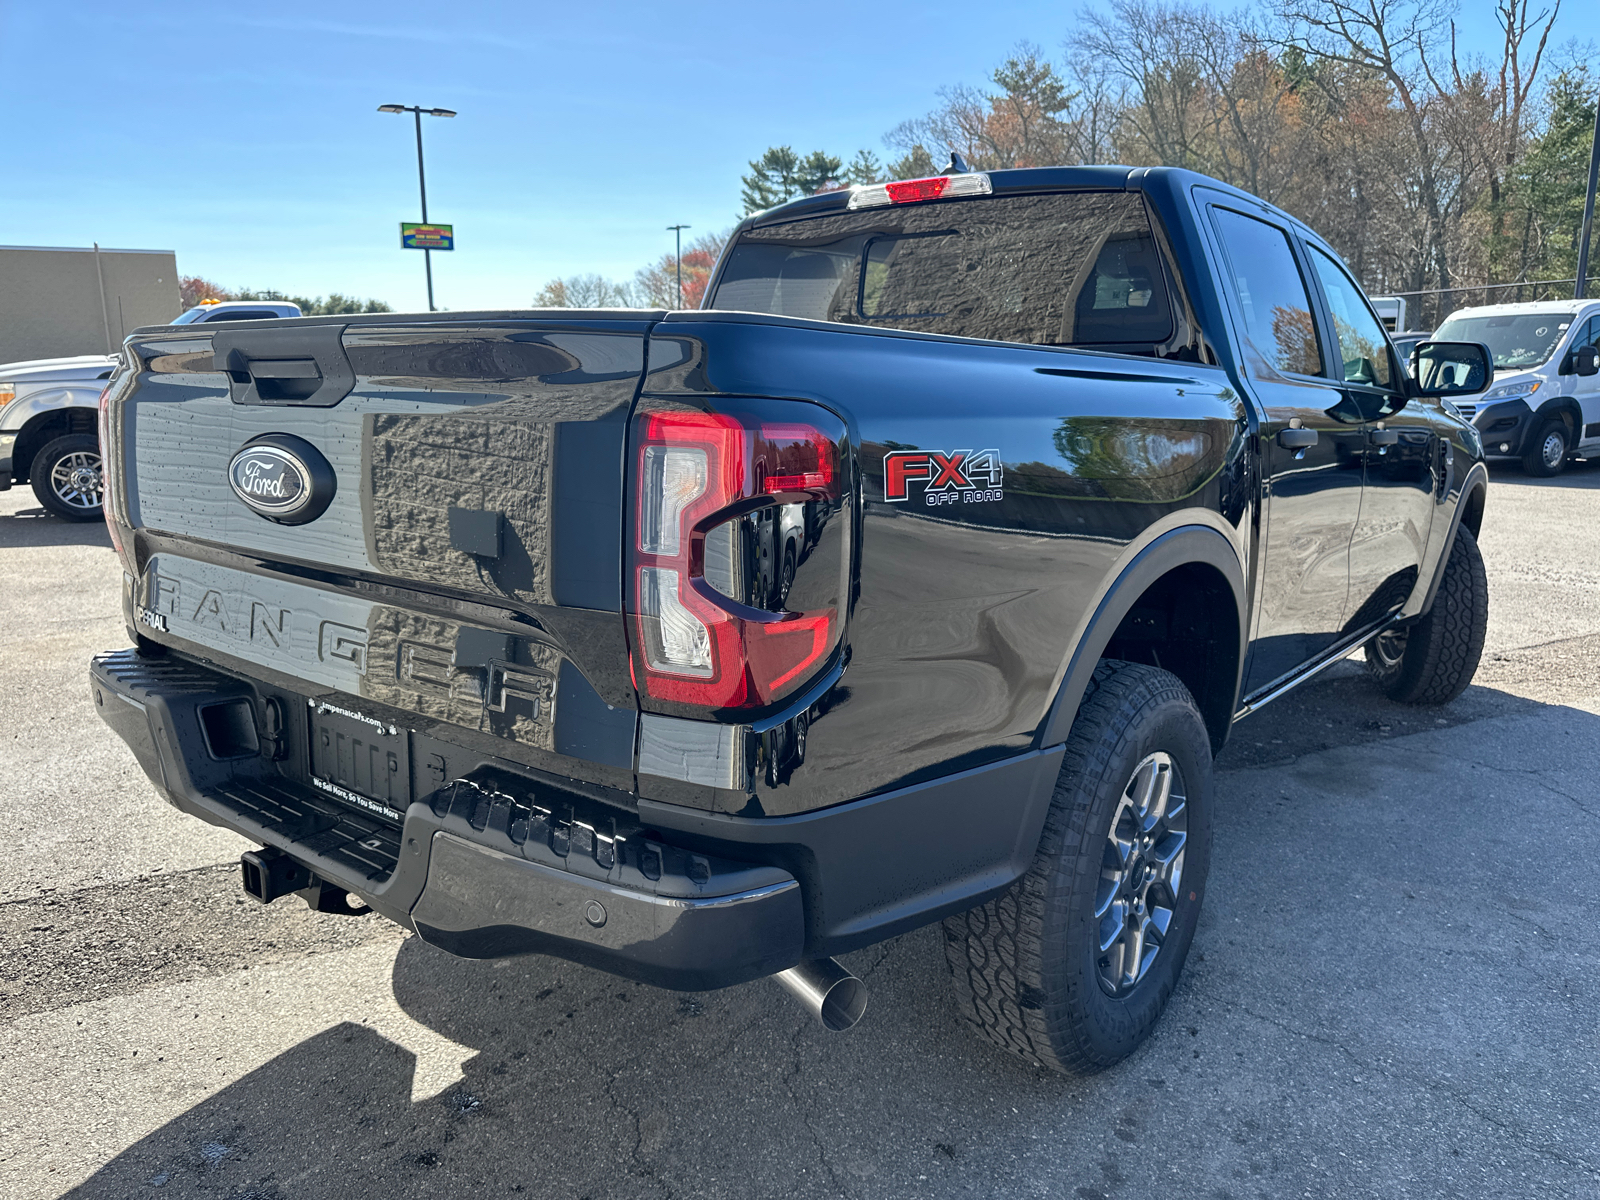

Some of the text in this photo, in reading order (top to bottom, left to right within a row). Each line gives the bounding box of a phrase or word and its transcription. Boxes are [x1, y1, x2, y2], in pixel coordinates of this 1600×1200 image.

[242, 460, 285, 497] Ford
[883, 449, 1003, 502] FX4
[926, 489, 1003, 506] OFF ROAD
[135, 605, 166, 632] PERIAL
[154, 575, 557, 724] RANGER
[313, 777, 399, 820] We Sell More, So You Save More
